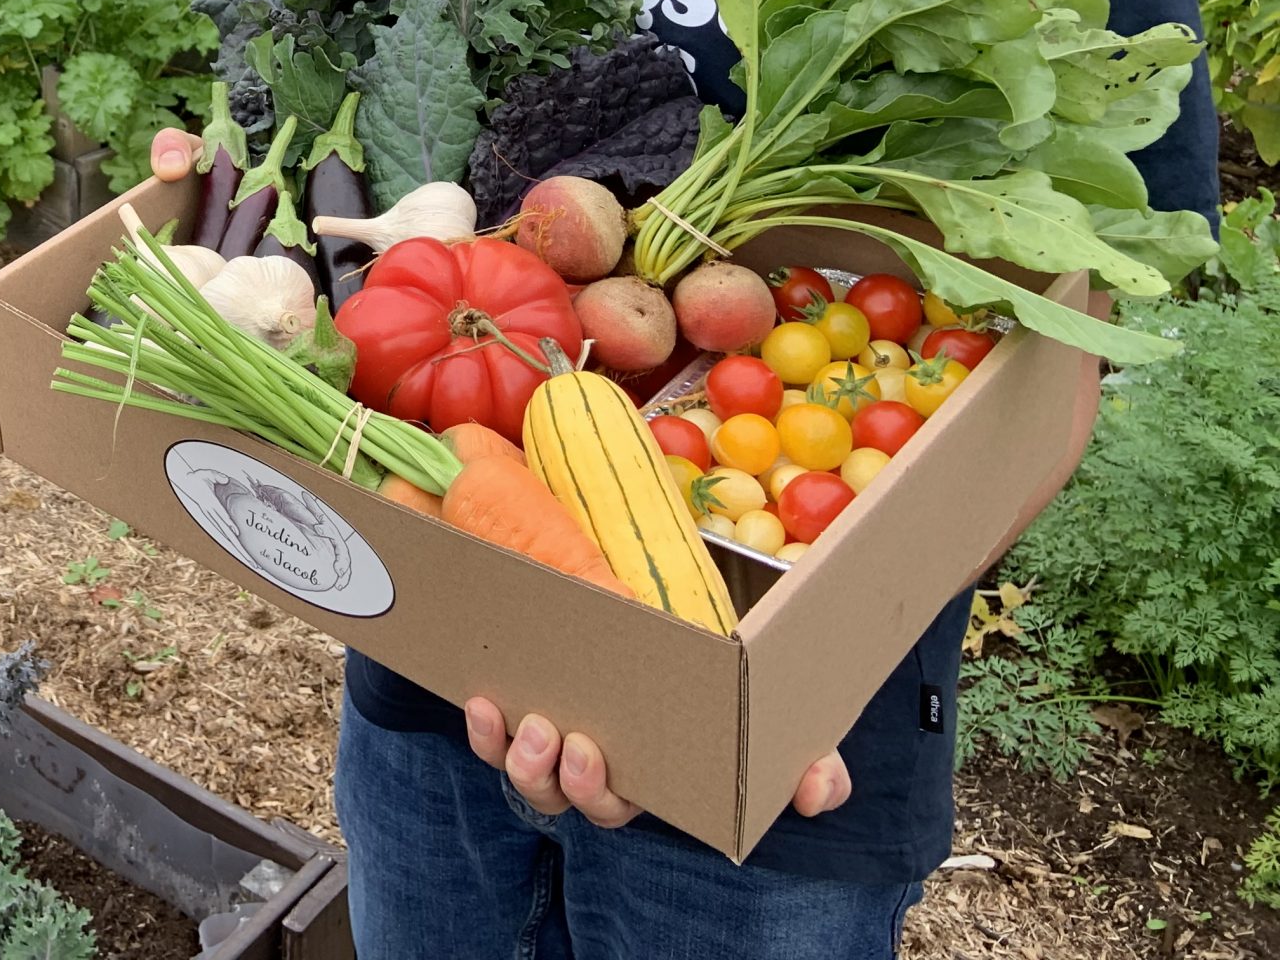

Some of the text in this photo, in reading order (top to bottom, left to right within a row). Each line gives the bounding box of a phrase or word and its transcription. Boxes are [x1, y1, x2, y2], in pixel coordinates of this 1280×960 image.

[246, 509, 311, 557] Jardins
[259, 548, 320, 586] de Jacob
[930, 695, 940, 723] ethica
